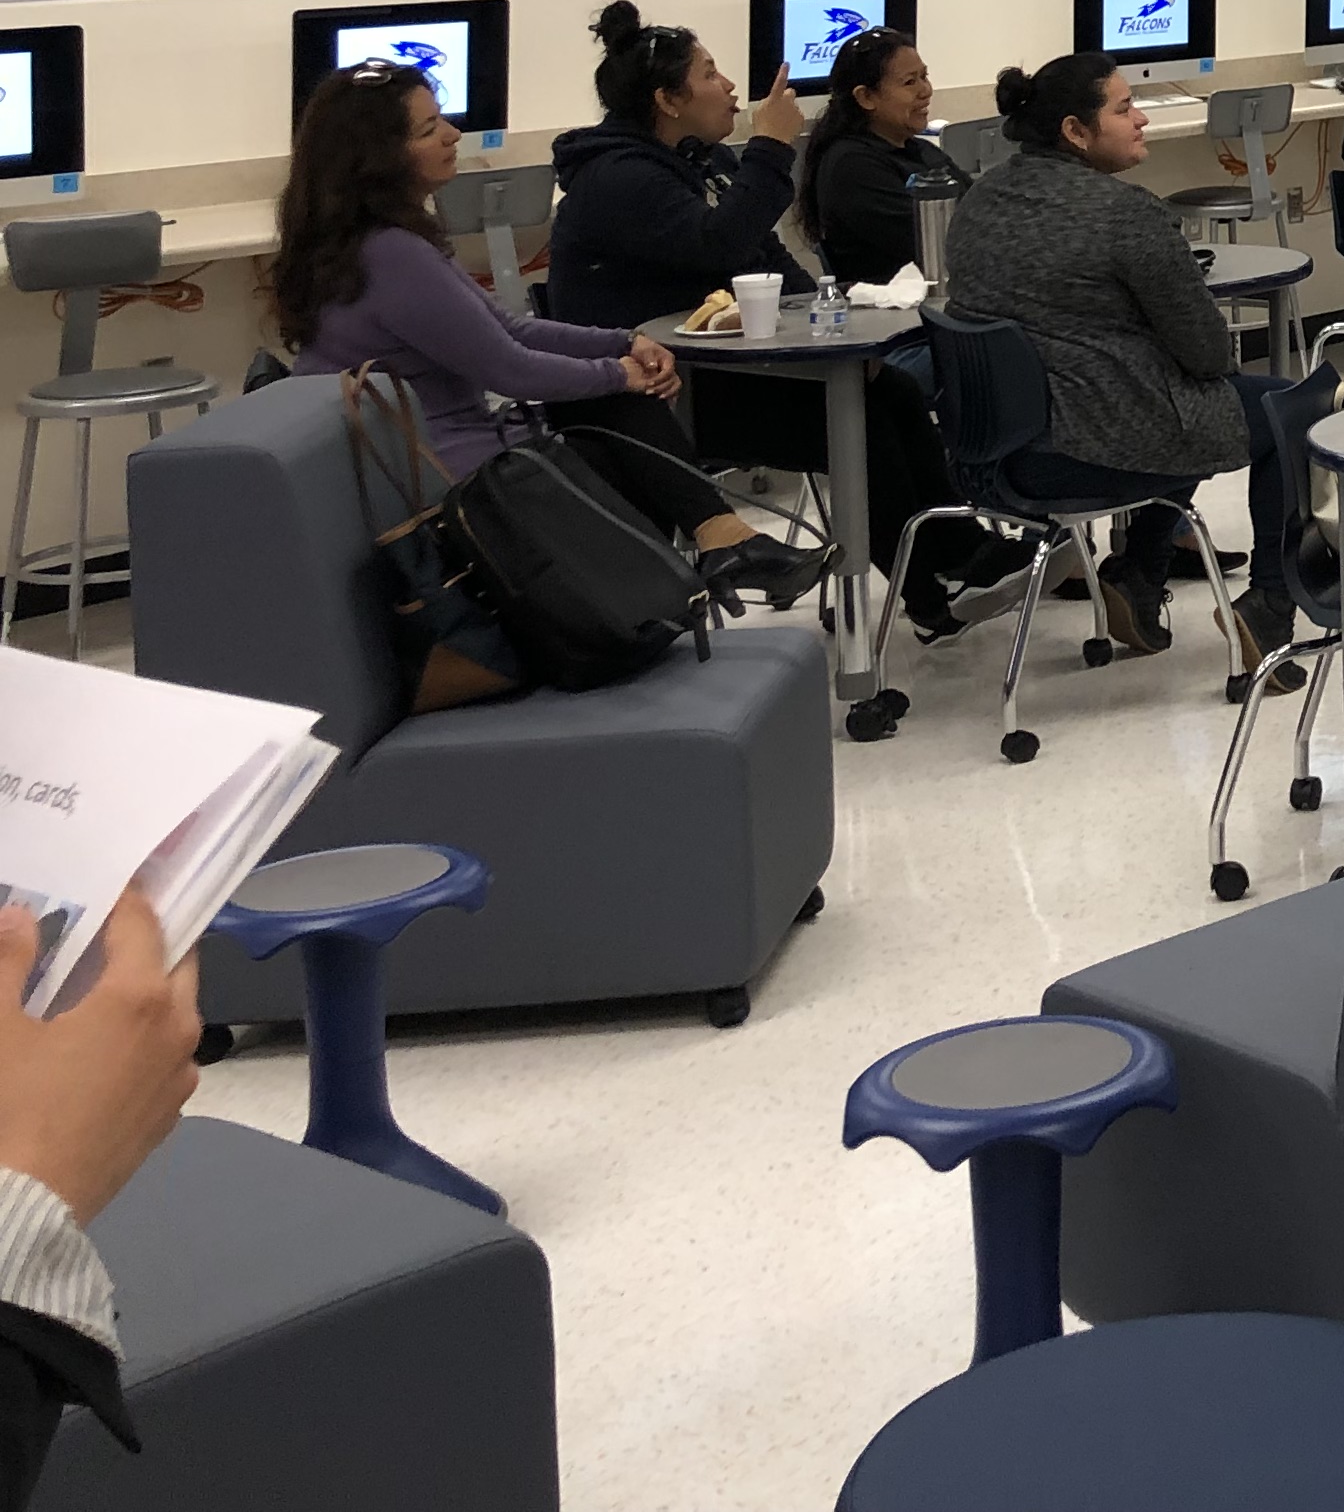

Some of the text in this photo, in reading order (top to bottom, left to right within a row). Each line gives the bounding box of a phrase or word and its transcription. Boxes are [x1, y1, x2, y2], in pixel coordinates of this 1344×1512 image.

[1118, 16, 1172, 33] FALCONS
[801, 42, 840, 61] FALC
[24, 781, 80, 820] cards,
